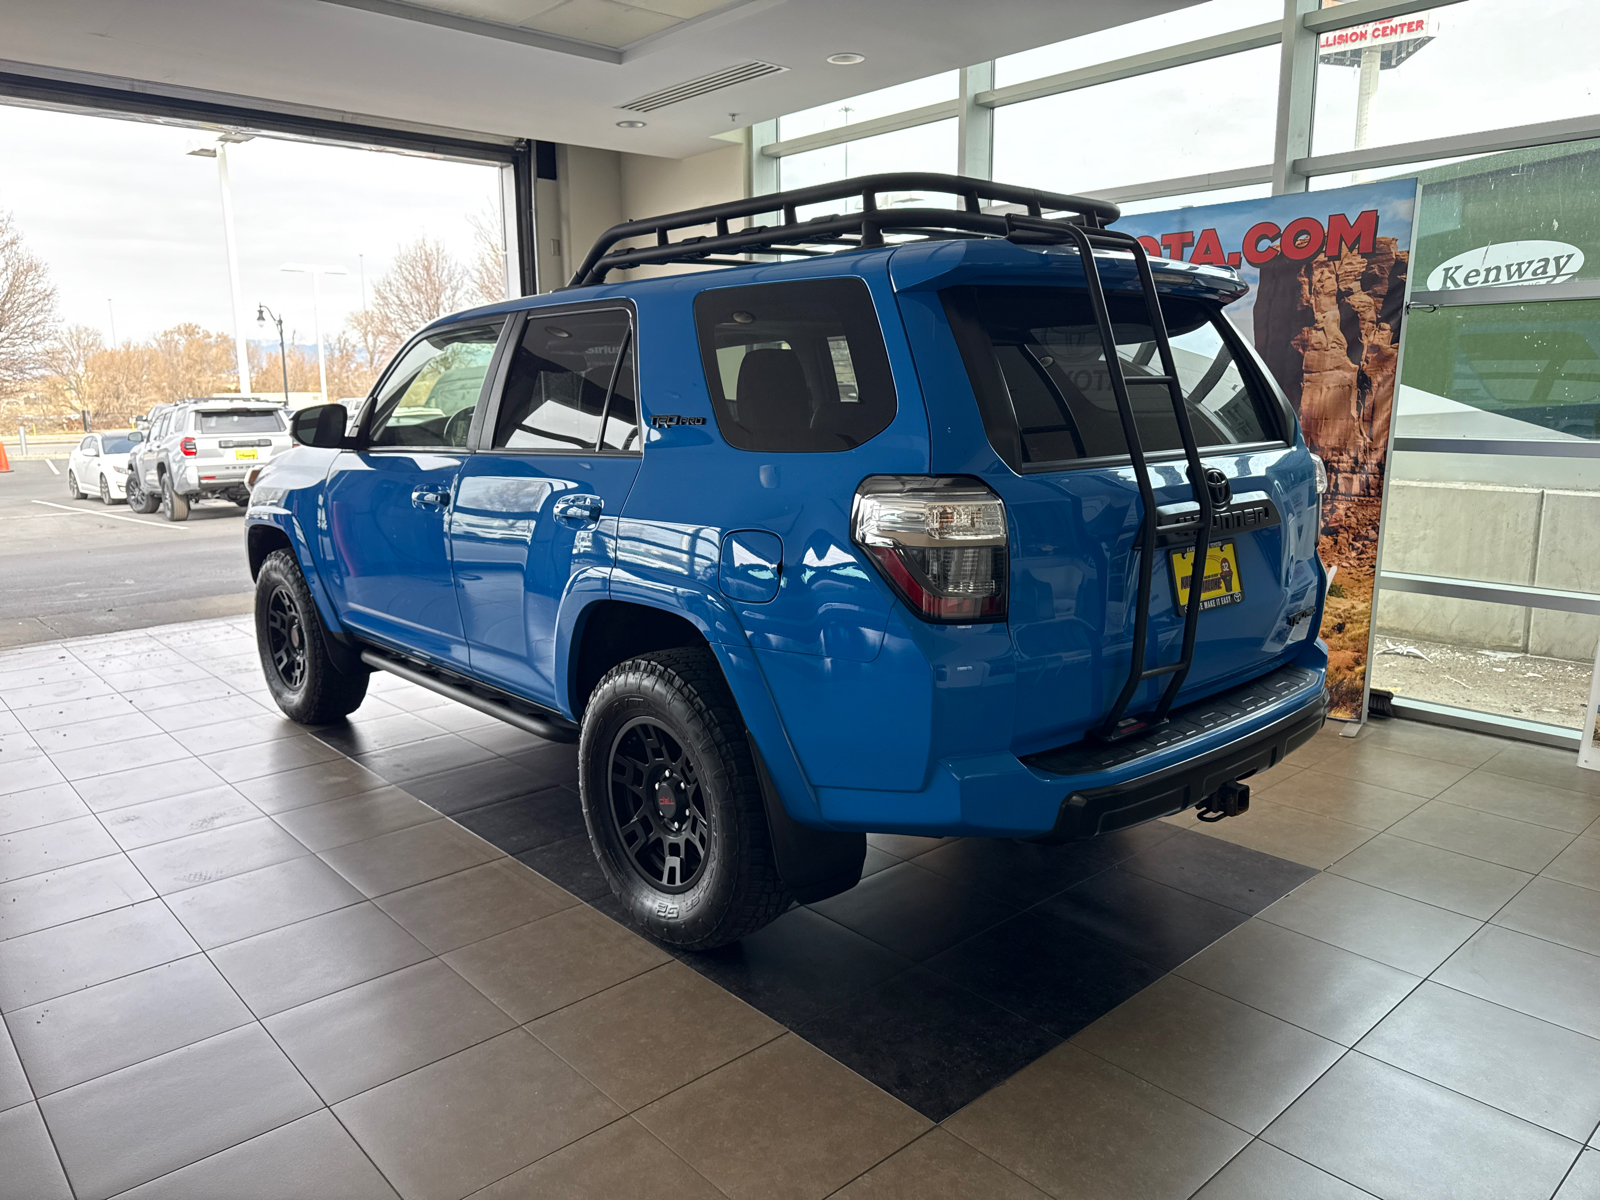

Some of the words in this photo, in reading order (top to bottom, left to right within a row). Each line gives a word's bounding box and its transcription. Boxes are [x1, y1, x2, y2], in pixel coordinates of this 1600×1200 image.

[1372, 19, 1424, 39] CENTER
[1438, 252, 1575, 290] Kenway
[680, 416, 706, 426] PRO
[1221, 562, 1230, 572] 32
[1203, 599, 1216, 609] MAKE
[1216, 598, 1221, 606] IT
[1220, 595, 1232, 605] EASY
